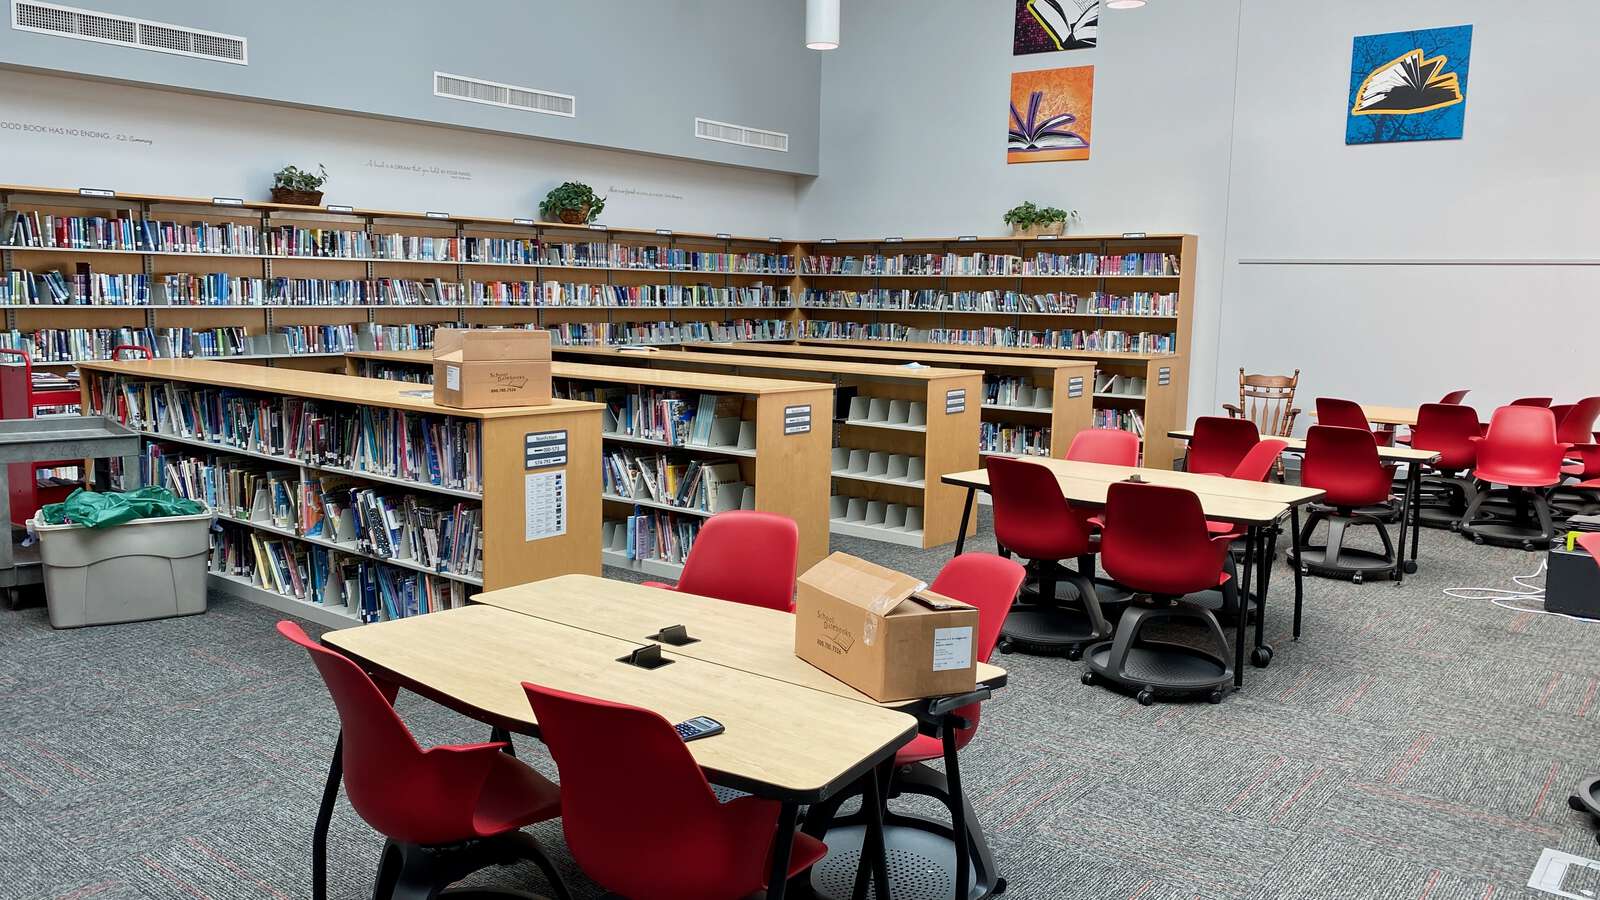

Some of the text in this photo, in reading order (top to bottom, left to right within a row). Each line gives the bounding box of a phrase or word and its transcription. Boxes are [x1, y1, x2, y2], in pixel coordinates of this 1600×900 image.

[23, 123, 47, 133] BOOK
[48, 127, 64, 135] HAS
[65, 128, 79, 137] NO
